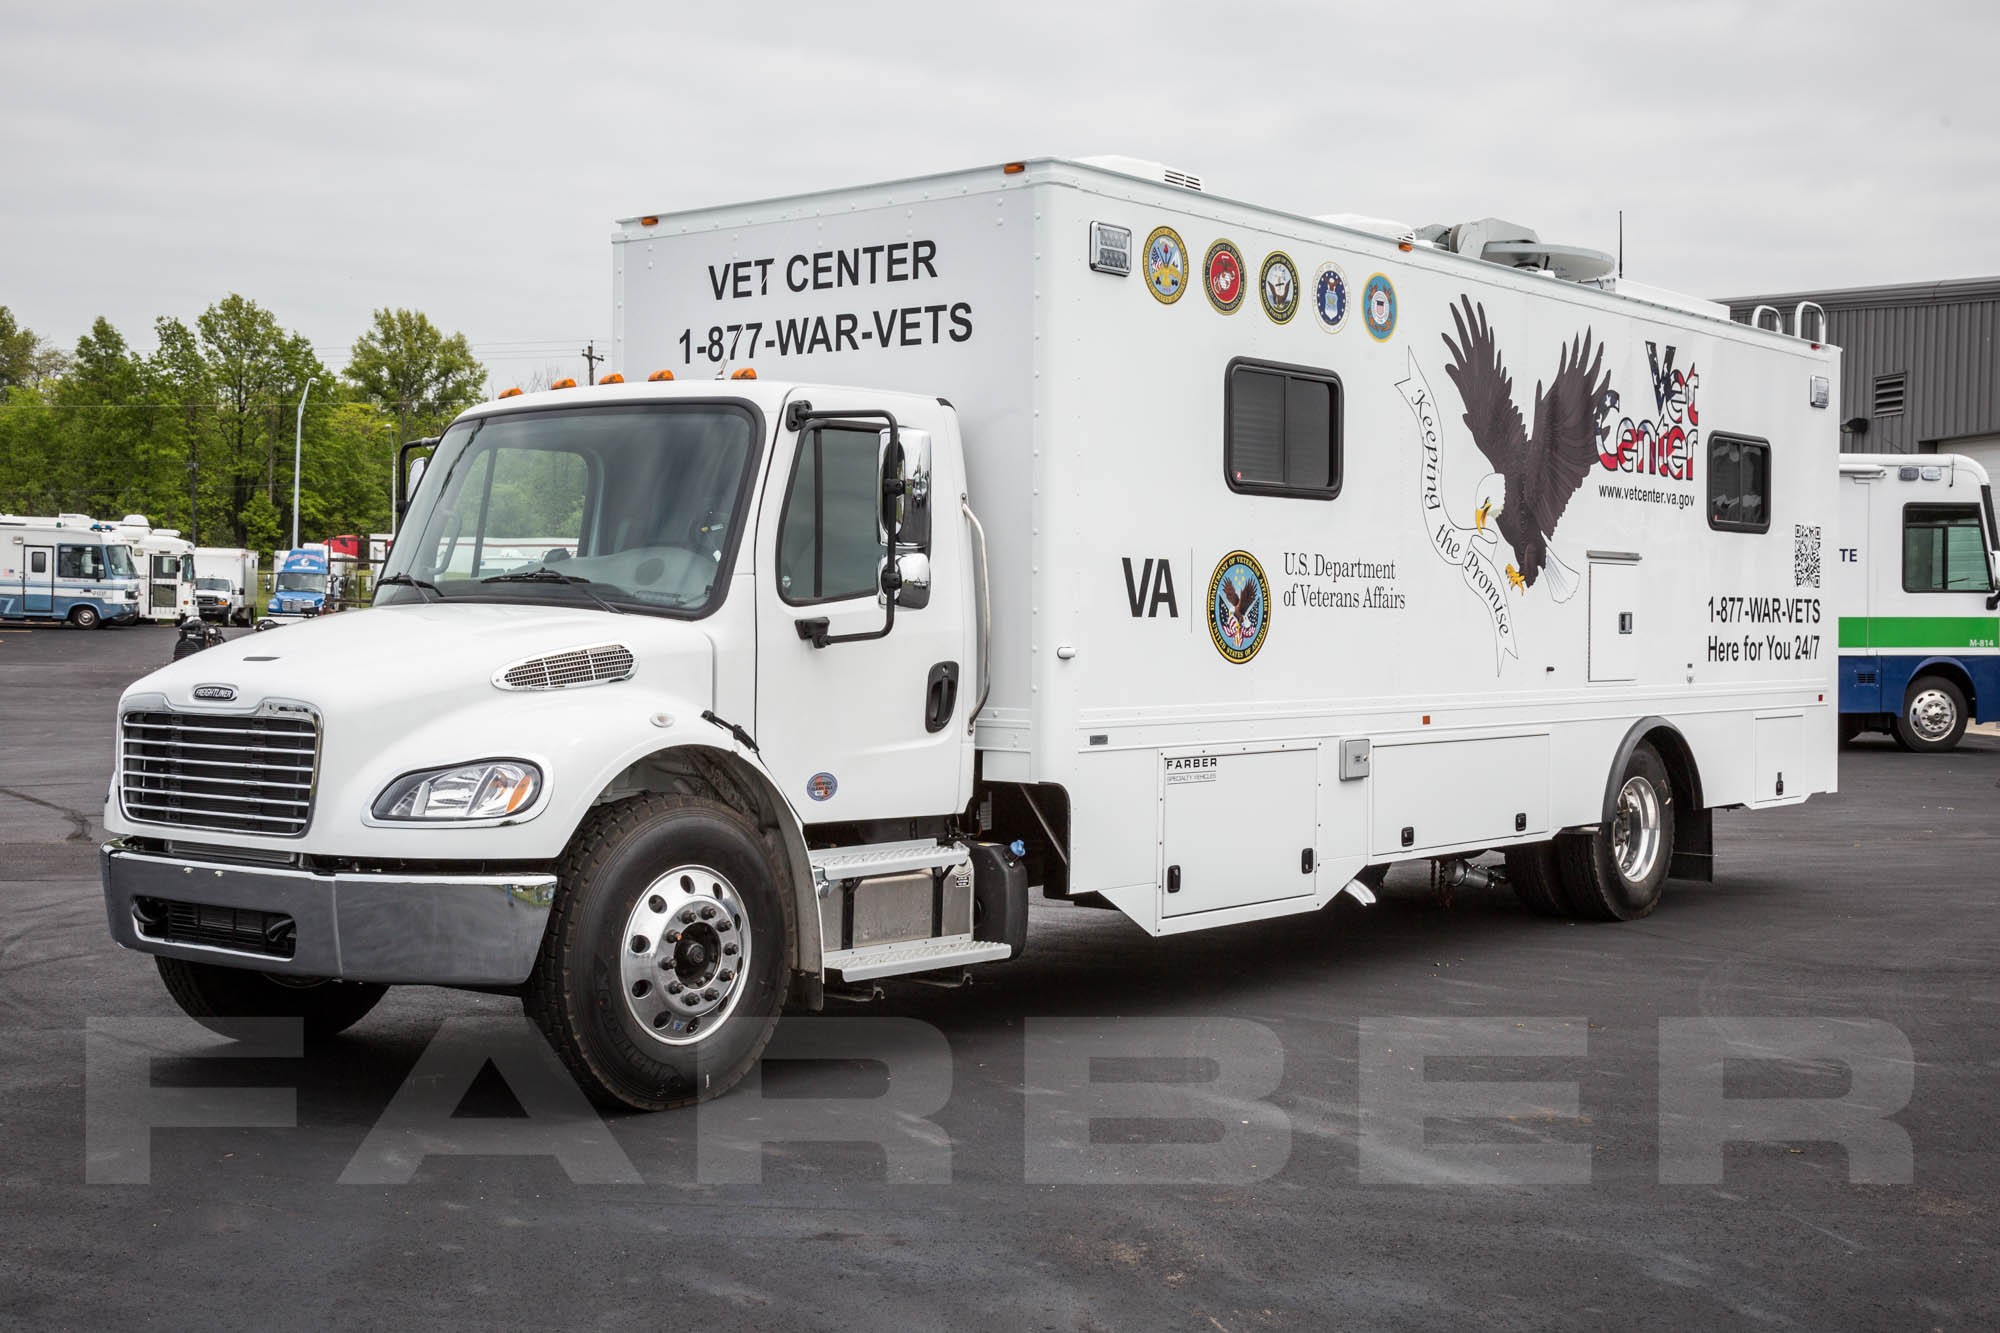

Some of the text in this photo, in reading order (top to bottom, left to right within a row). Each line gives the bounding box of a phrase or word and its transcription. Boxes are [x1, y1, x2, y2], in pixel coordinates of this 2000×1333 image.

[708, 240, 938, 300] VET CENTER
[679, 302, 973, 364] 1-877-WAR-VETS
[1645, 341, 1699, 427] Vet
[1595, 390, 1699, 480] Center
[1411, 389, 1509, 636] Keeping the Promise
[1599, 484, 1695, 510] www.vetcenter.va.gov
[1284, 552, 1396, 583] U.S. Department
[1122, 557, 1179, 618] VA
[1284, 584, 1406, 610] of Veterans Affairs
[1708, 596, 1821, 624] 1-877-WAR-VETS
[1708, 635, 1820, 662] Here for You 24/7
[1969, 639, 1994, 648] M-814
[1166, 758, 1217, 770] FARBER
